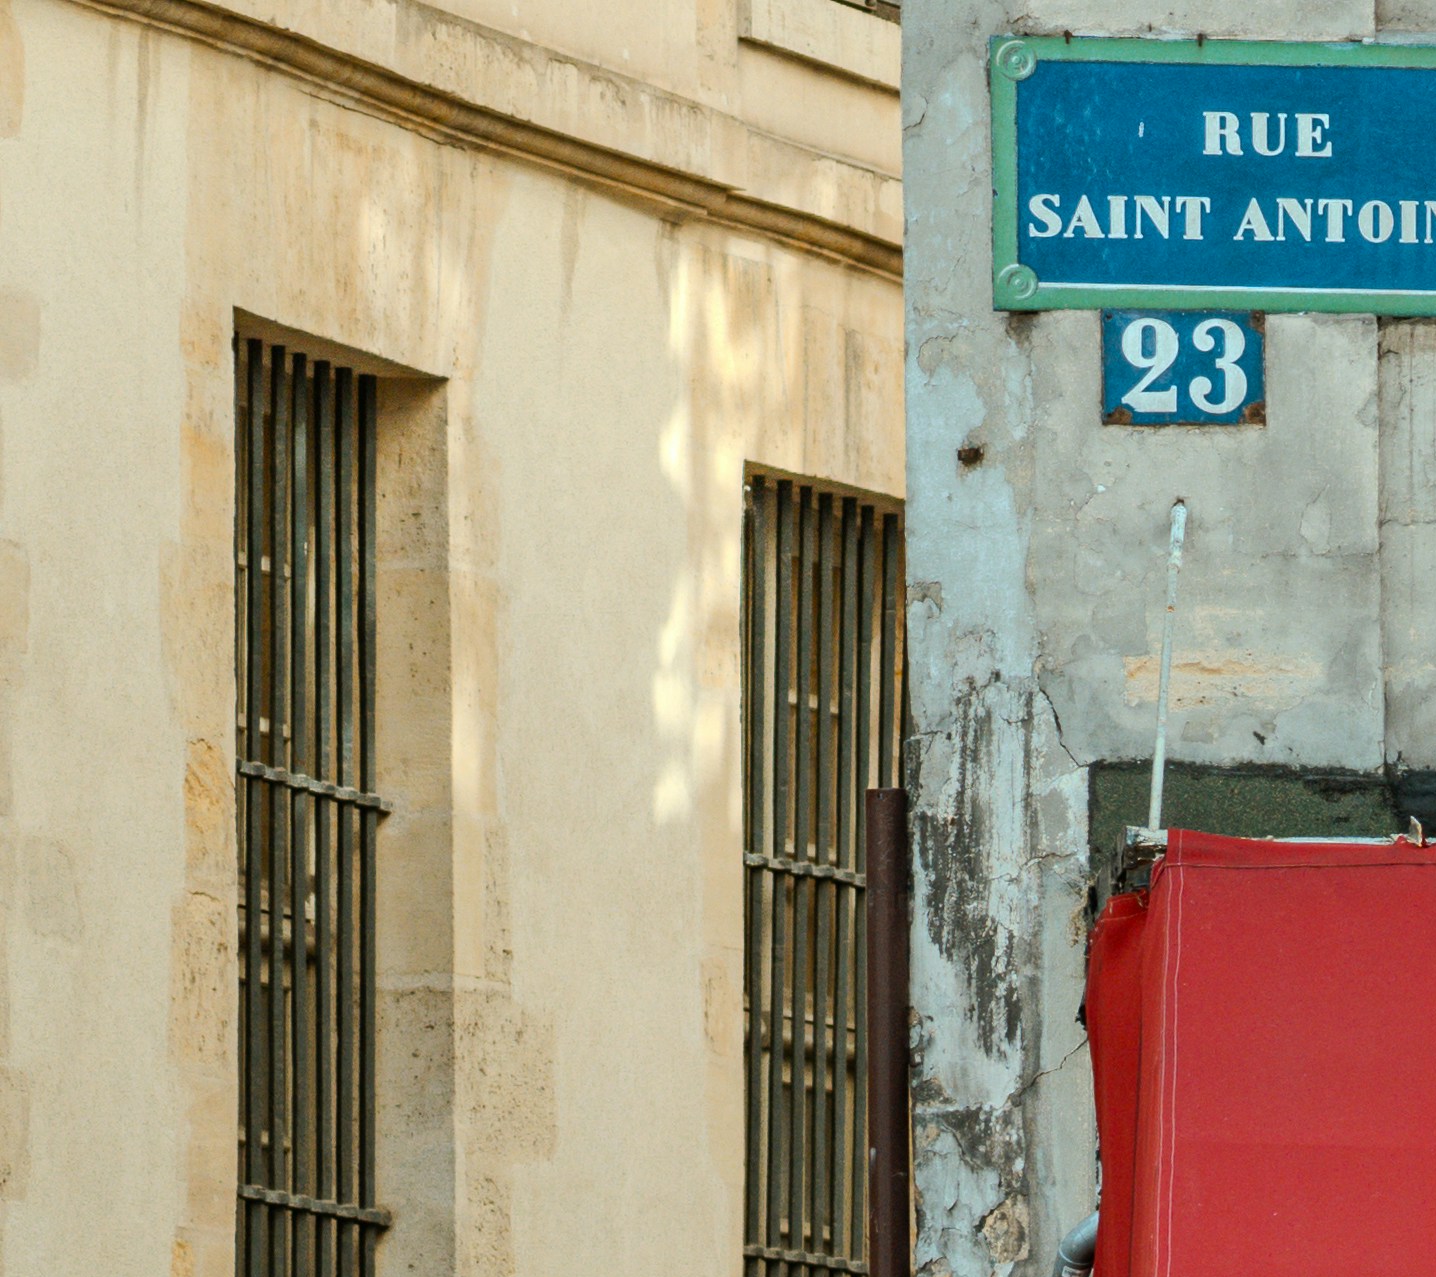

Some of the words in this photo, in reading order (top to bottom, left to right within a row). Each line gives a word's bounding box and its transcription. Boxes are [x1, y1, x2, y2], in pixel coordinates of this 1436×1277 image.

[1203, 111, 1333, 157] RUE
[1028, 194, 1211, 240] SAINT
[1121, 317, 1248, 415] 23
